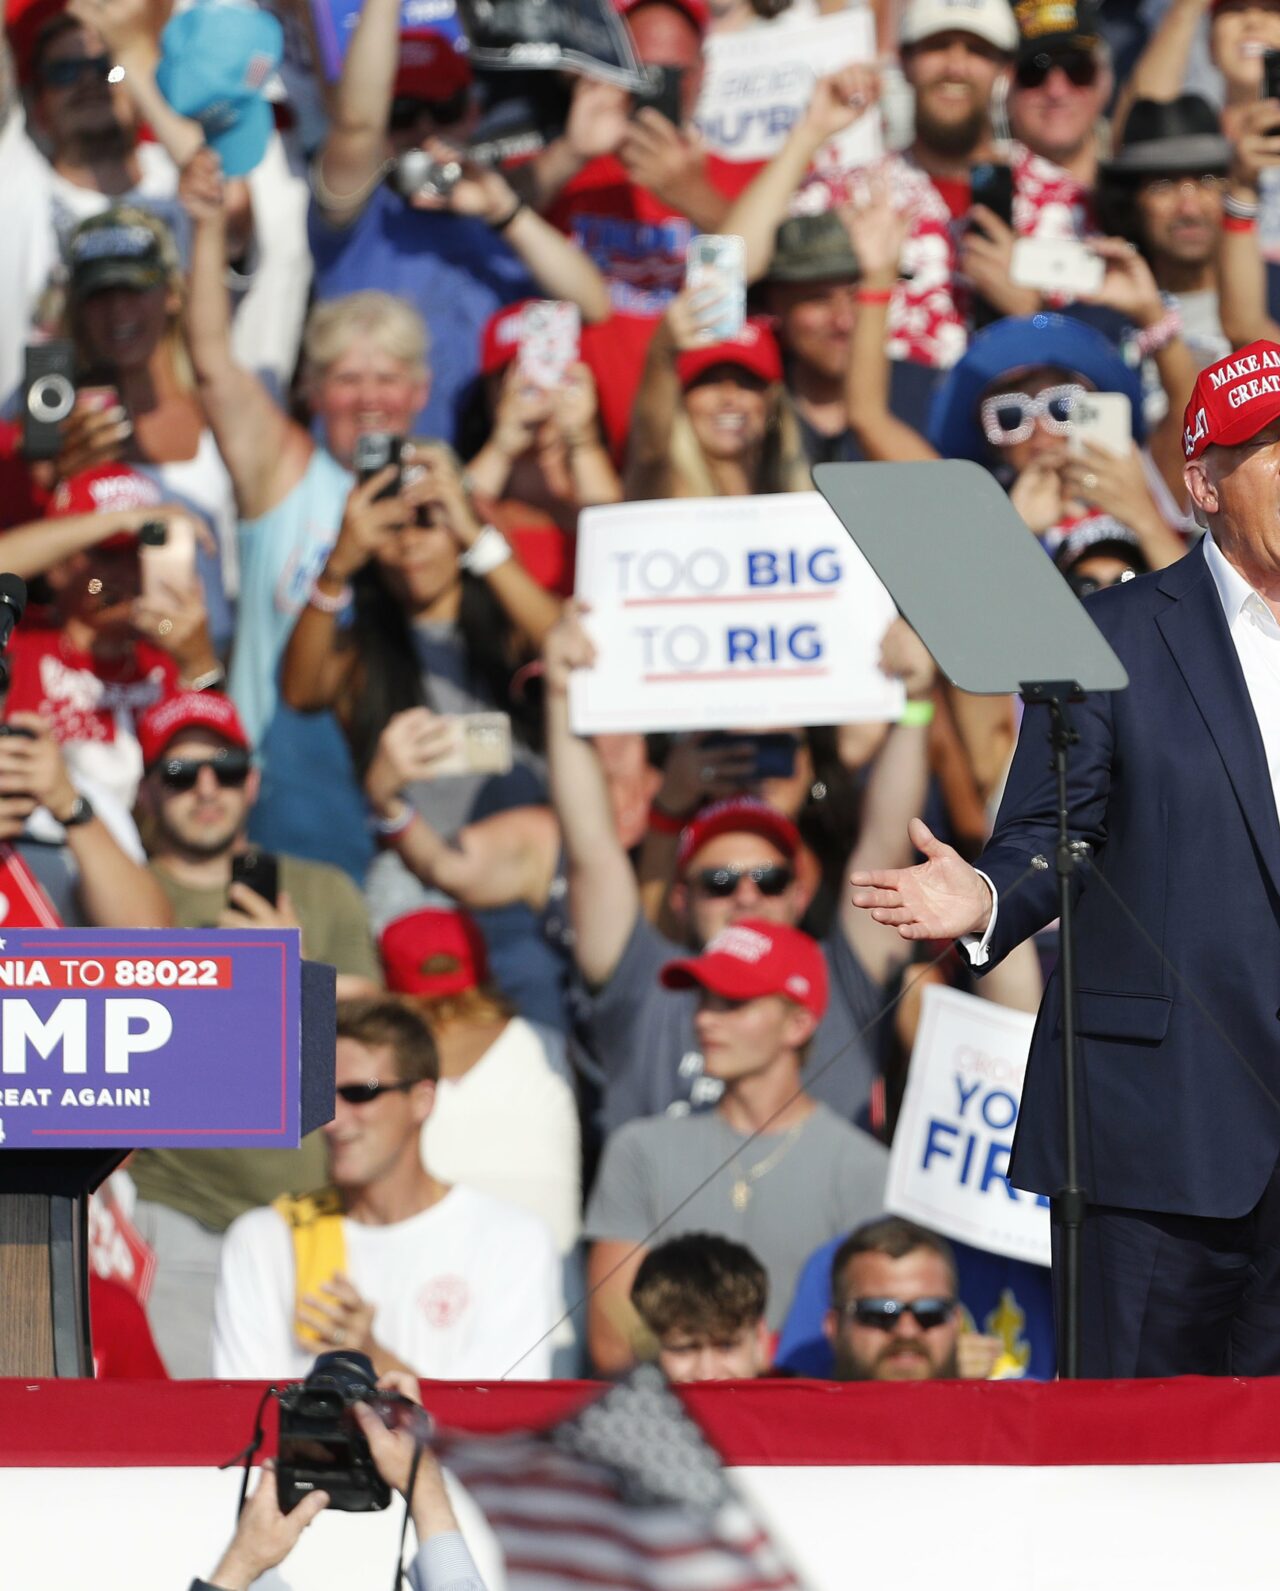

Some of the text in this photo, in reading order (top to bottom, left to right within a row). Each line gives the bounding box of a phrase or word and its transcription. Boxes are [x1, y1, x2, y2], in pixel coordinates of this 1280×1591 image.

[1209, 354, 1261, 390] MAKE
[1227, 374, 1280, 409] GREAT
[612, 547, 843, 594] TOO BIG
[633, 624, 823, 671] TO RIG
[60, 961, 104, 986] TO
[115, 960, 218, 986] 88022
[2, 998, 173, 1074] MP
[60, 1089, 150, 1106] AGAIN!
[921, 1119, 1050, 1209] FIR
